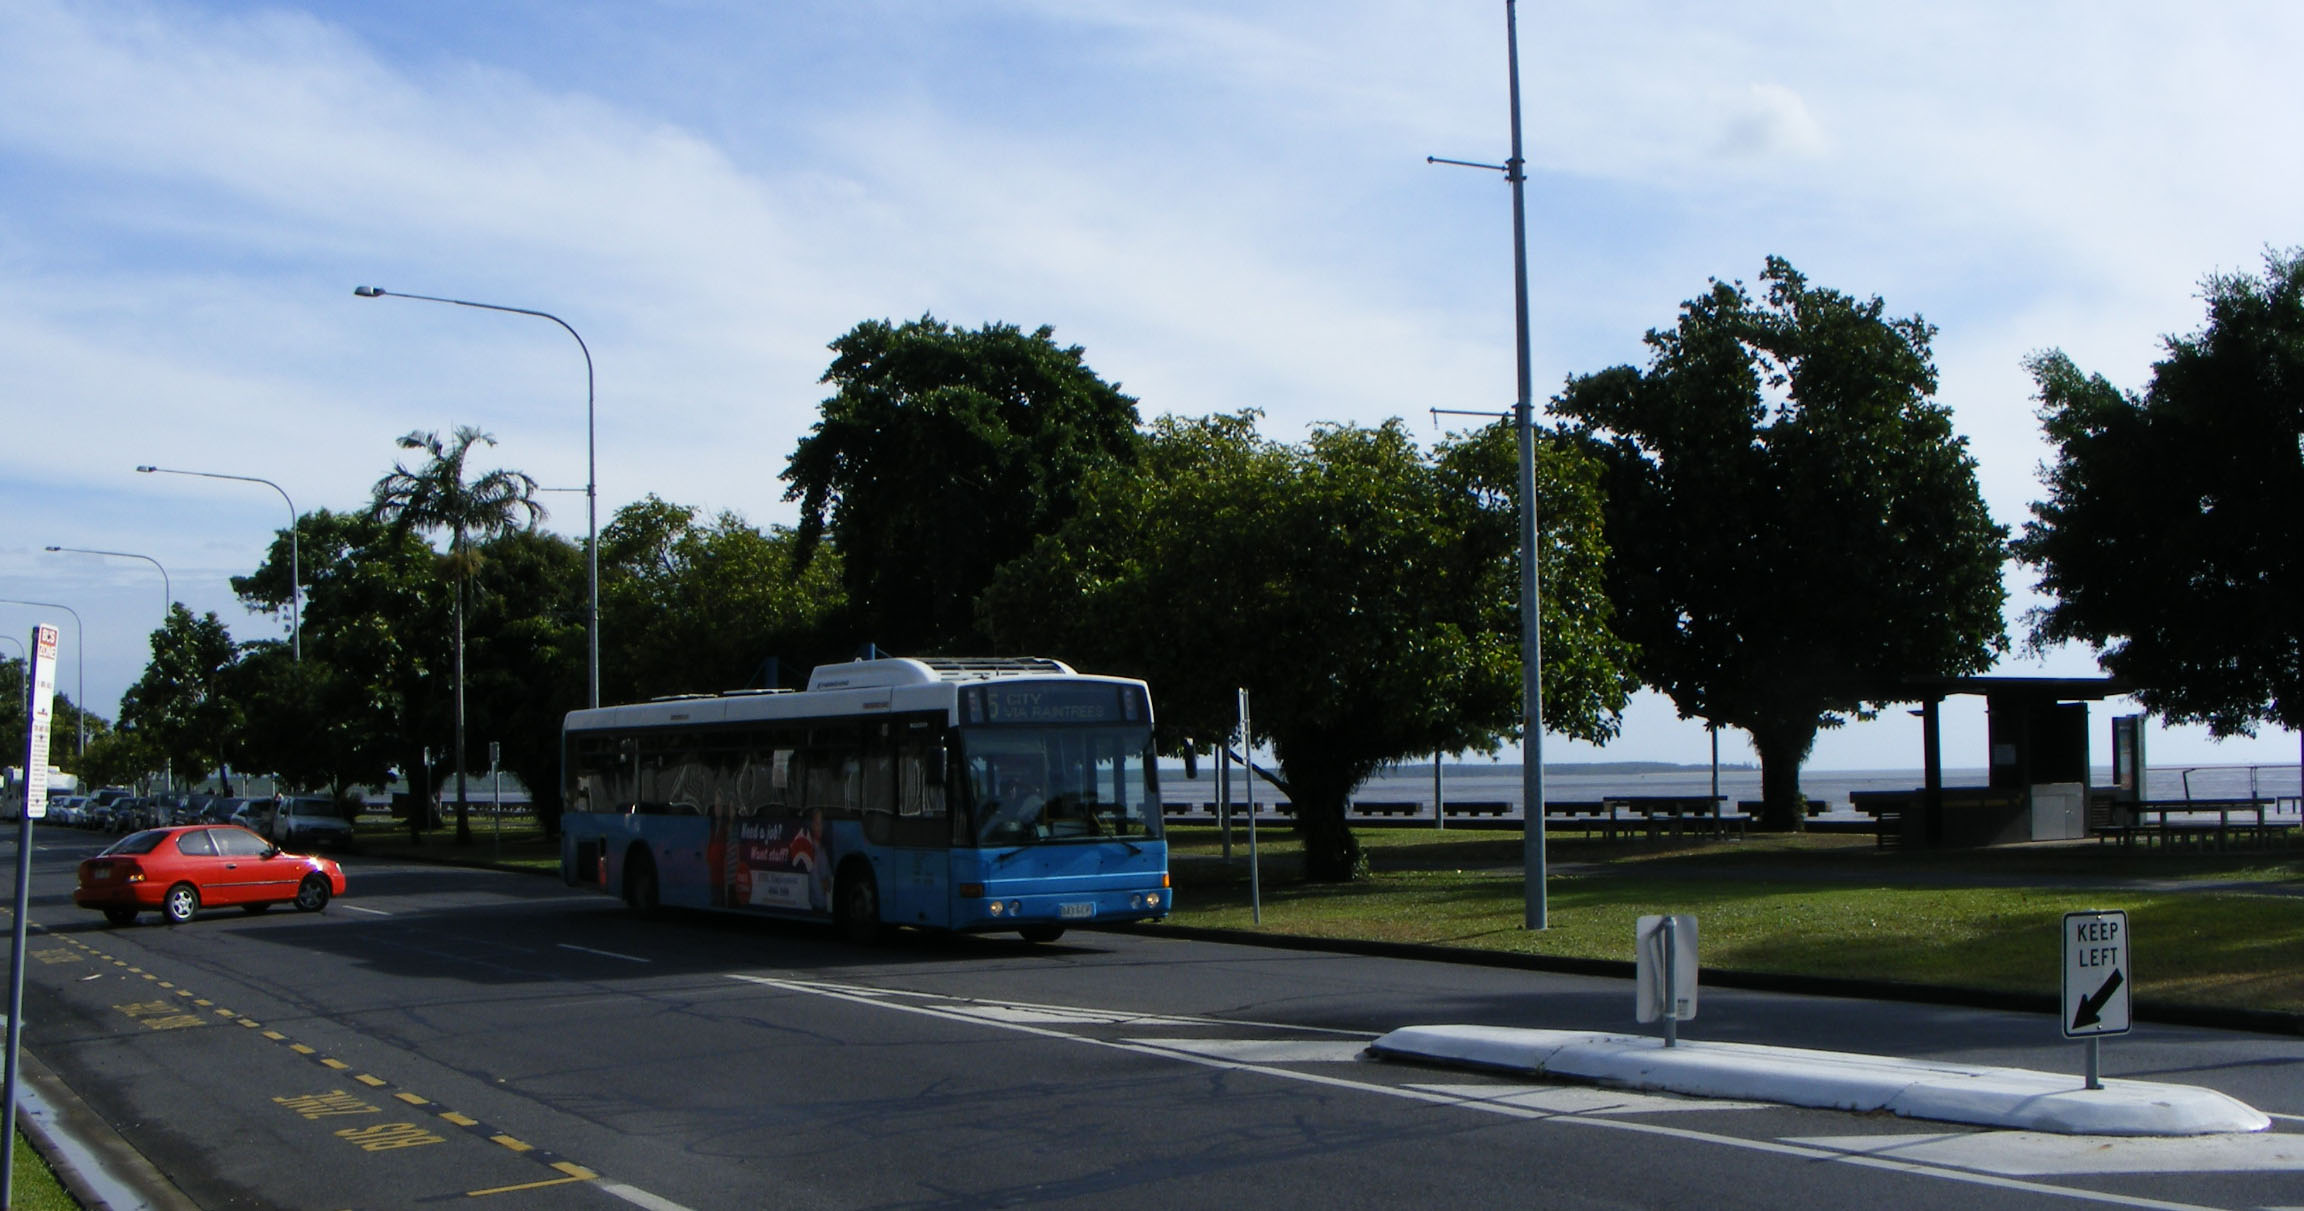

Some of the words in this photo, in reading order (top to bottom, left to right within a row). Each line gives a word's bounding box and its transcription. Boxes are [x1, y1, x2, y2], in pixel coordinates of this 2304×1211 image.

[1007, 693, 1041, 705] CITY
[1004, 706, 1028, 719] VIA
[741, 823, 759, 840] Need
[2077, 922, 2118, 942] KEEP
[2079, 947, 2118, 967] LEFT
